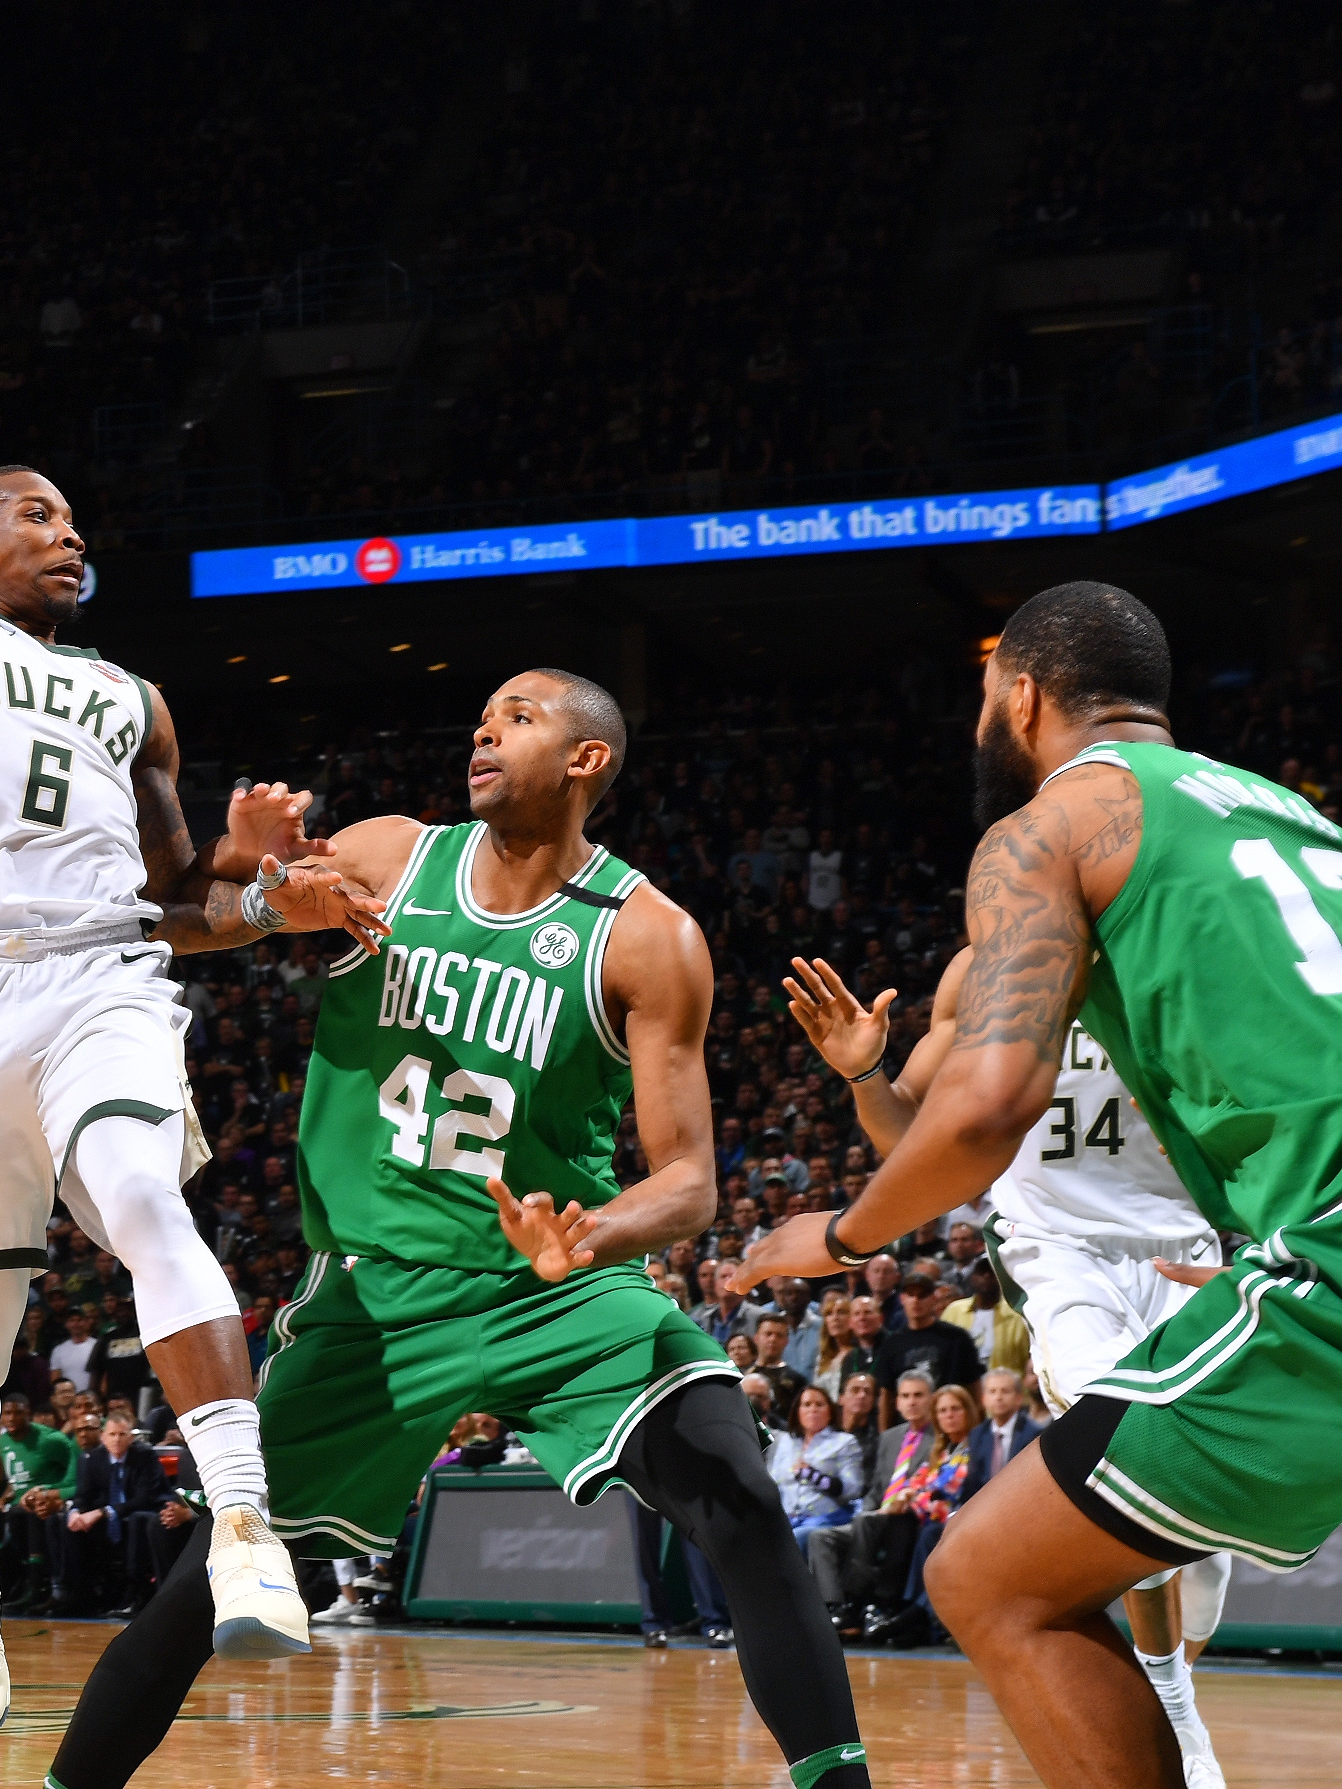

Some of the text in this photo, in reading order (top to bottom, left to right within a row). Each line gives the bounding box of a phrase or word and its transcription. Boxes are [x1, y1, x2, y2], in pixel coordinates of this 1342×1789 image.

[273, 534, 588, 580] BMO Harris Bank
[691, 520, 749, 551] The
[757, 508, 843, 545] bank
[847, 500, 920, 538] that
[923, 494, 1030, 538] brings
[19, 740, 74, 830] 6
[1230, 837, 1342, 996] 1
[378, 944, 564, 1071] BOSTON
[379, 1054, 516, 1179] 42
[1040, 1095, 1126, 1162] 34
